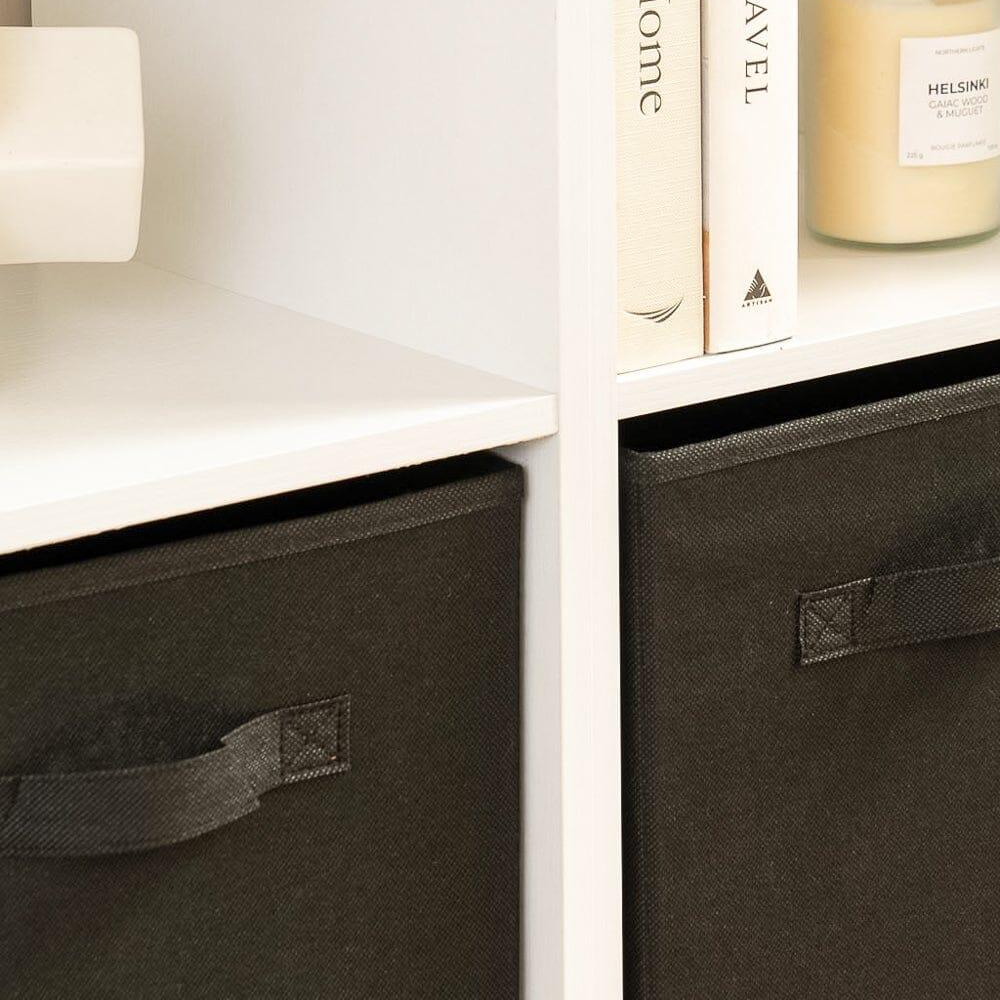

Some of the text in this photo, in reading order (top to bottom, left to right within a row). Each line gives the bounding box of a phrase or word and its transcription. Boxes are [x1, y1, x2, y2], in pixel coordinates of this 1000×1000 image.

[928, 78, 989, 96] HELSINKI
[928, 94, 989, 110] GAIAC WOOD
[936, 105, 983, 119] & MUGUET
